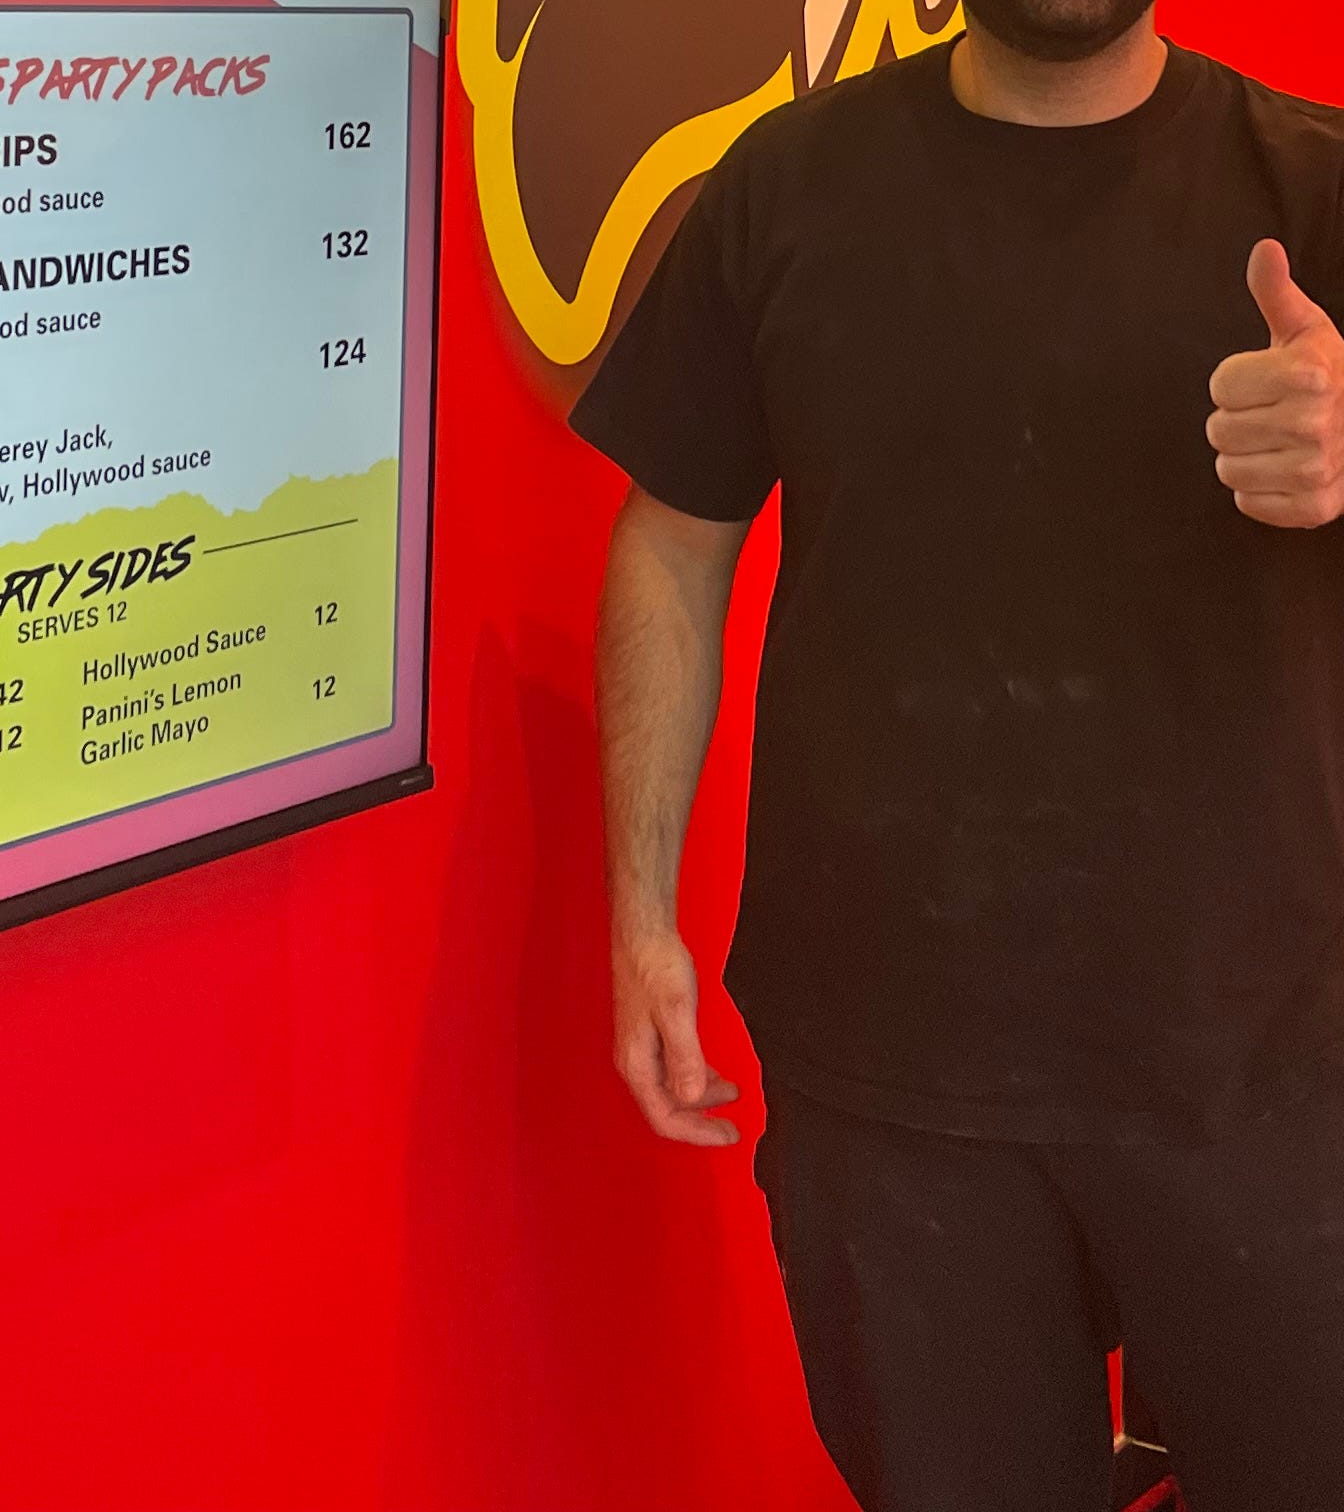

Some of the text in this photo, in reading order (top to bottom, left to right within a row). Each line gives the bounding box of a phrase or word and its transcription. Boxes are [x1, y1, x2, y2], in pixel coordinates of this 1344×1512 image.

[326, 122, 370, 149] 162
[40, 191, 103, 211] sauce
[323, 230, 368, 259] 132
[320, 338, 366, 368] 124
[56, 425, 112, 453] Jack,
[80, 534, 196, 599] SIDES
[18, 601, 127, 643] SERVES 12
[315, 602, 337, 625] 12
[84, 626, 266, 685] Hollywood Sauce
[82, 674, 241, 730] Panini's Lemon
[313, 676, 335, 699] 12
[81, 716, 208, 765] Garlic Mayo
